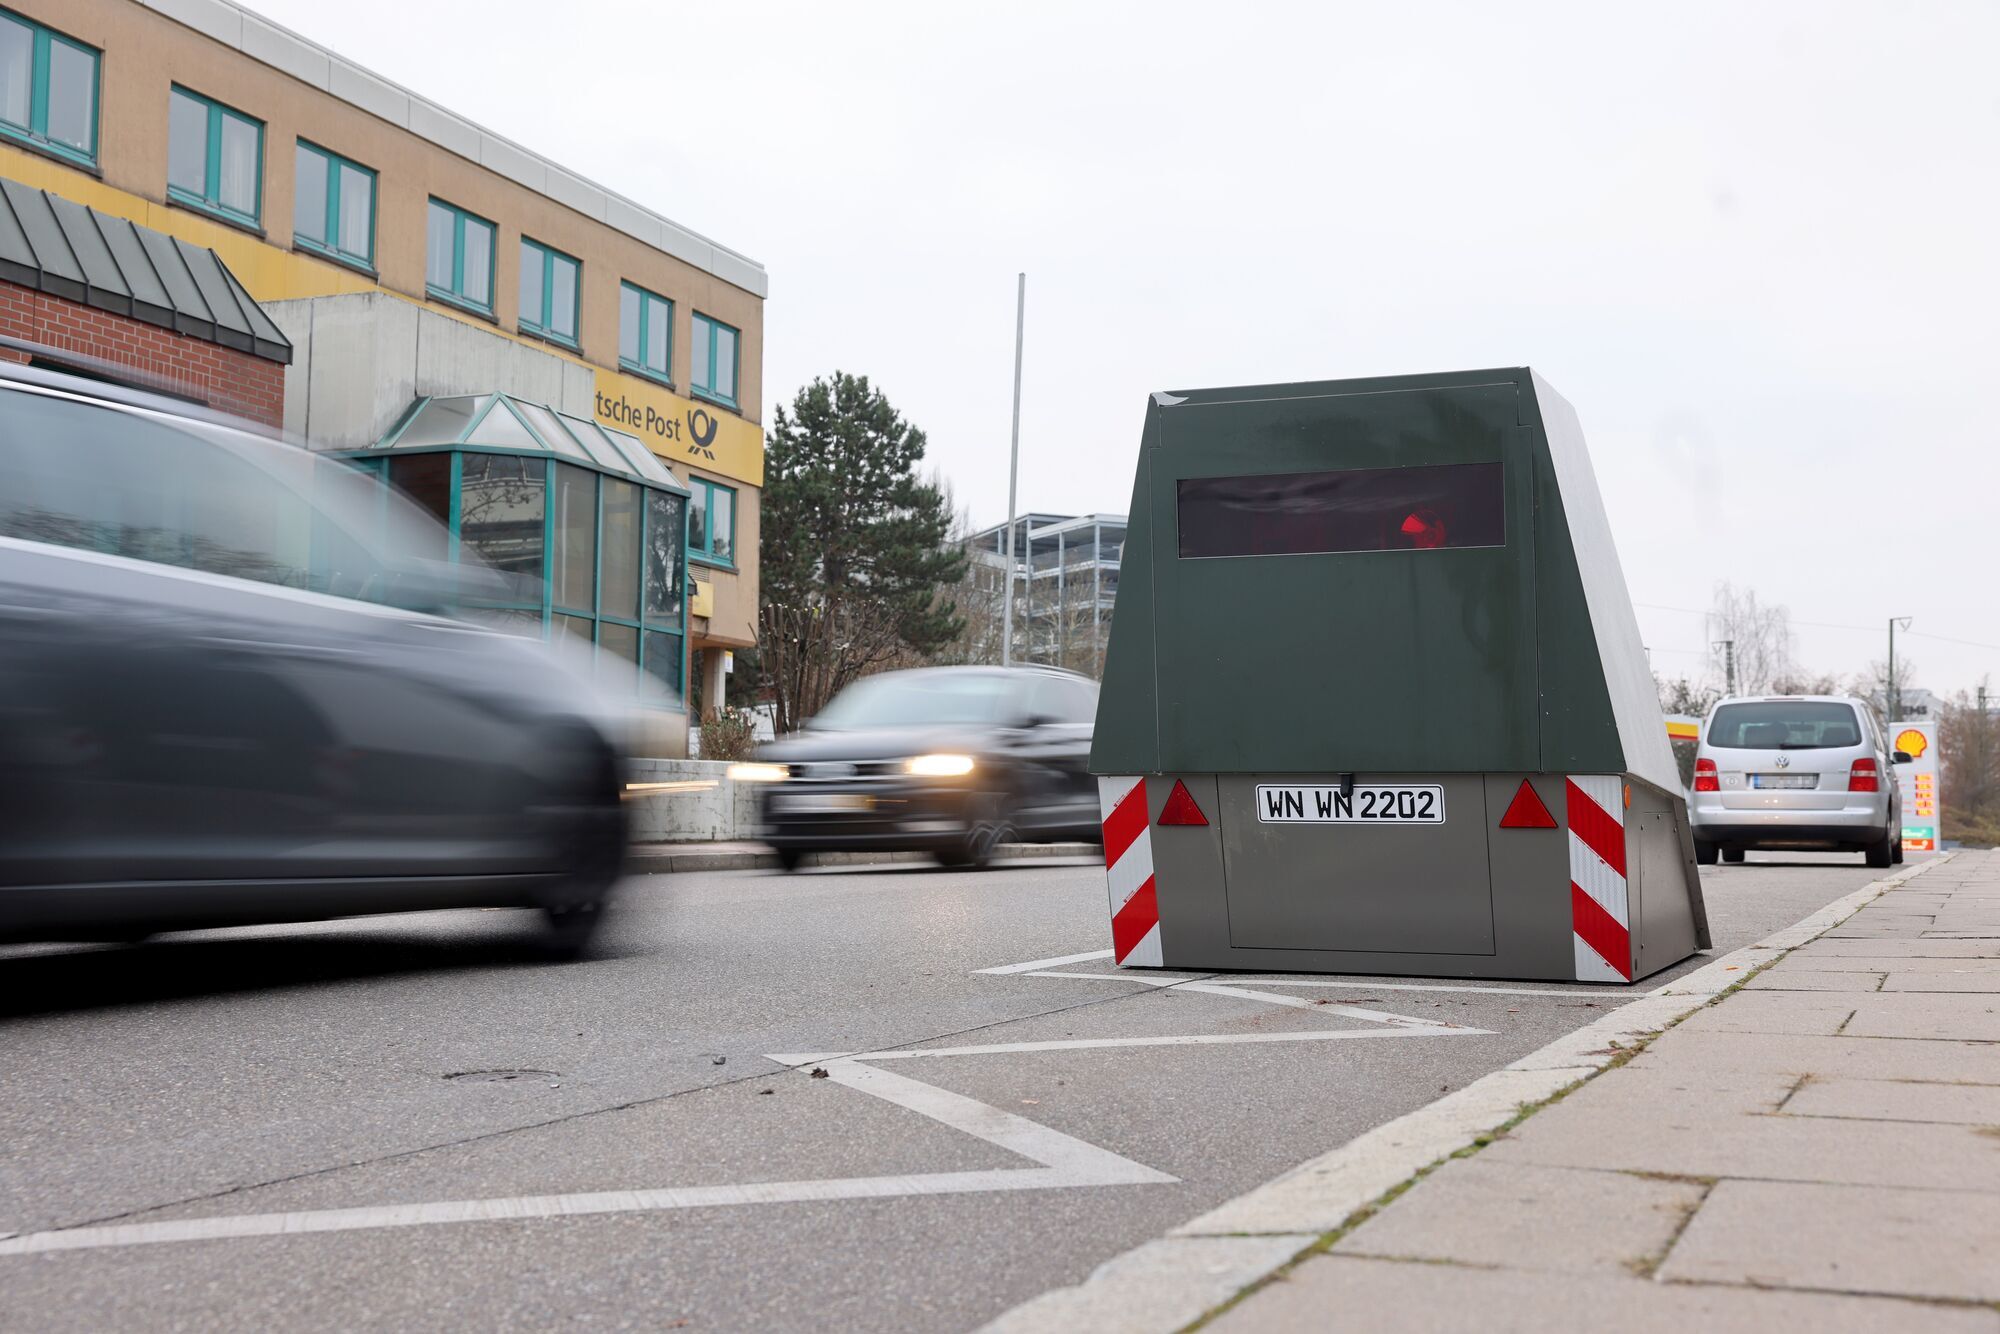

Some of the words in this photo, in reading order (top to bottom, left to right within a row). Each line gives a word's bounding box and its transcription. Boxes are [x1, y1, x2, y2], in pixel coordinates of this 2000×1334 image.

[646, 406, 681, 441] Post
[1266, 791, 1304, 818] WN
[1315, 791, 1353, 818] WN
[1360, 791, 1435, 819] 2202
